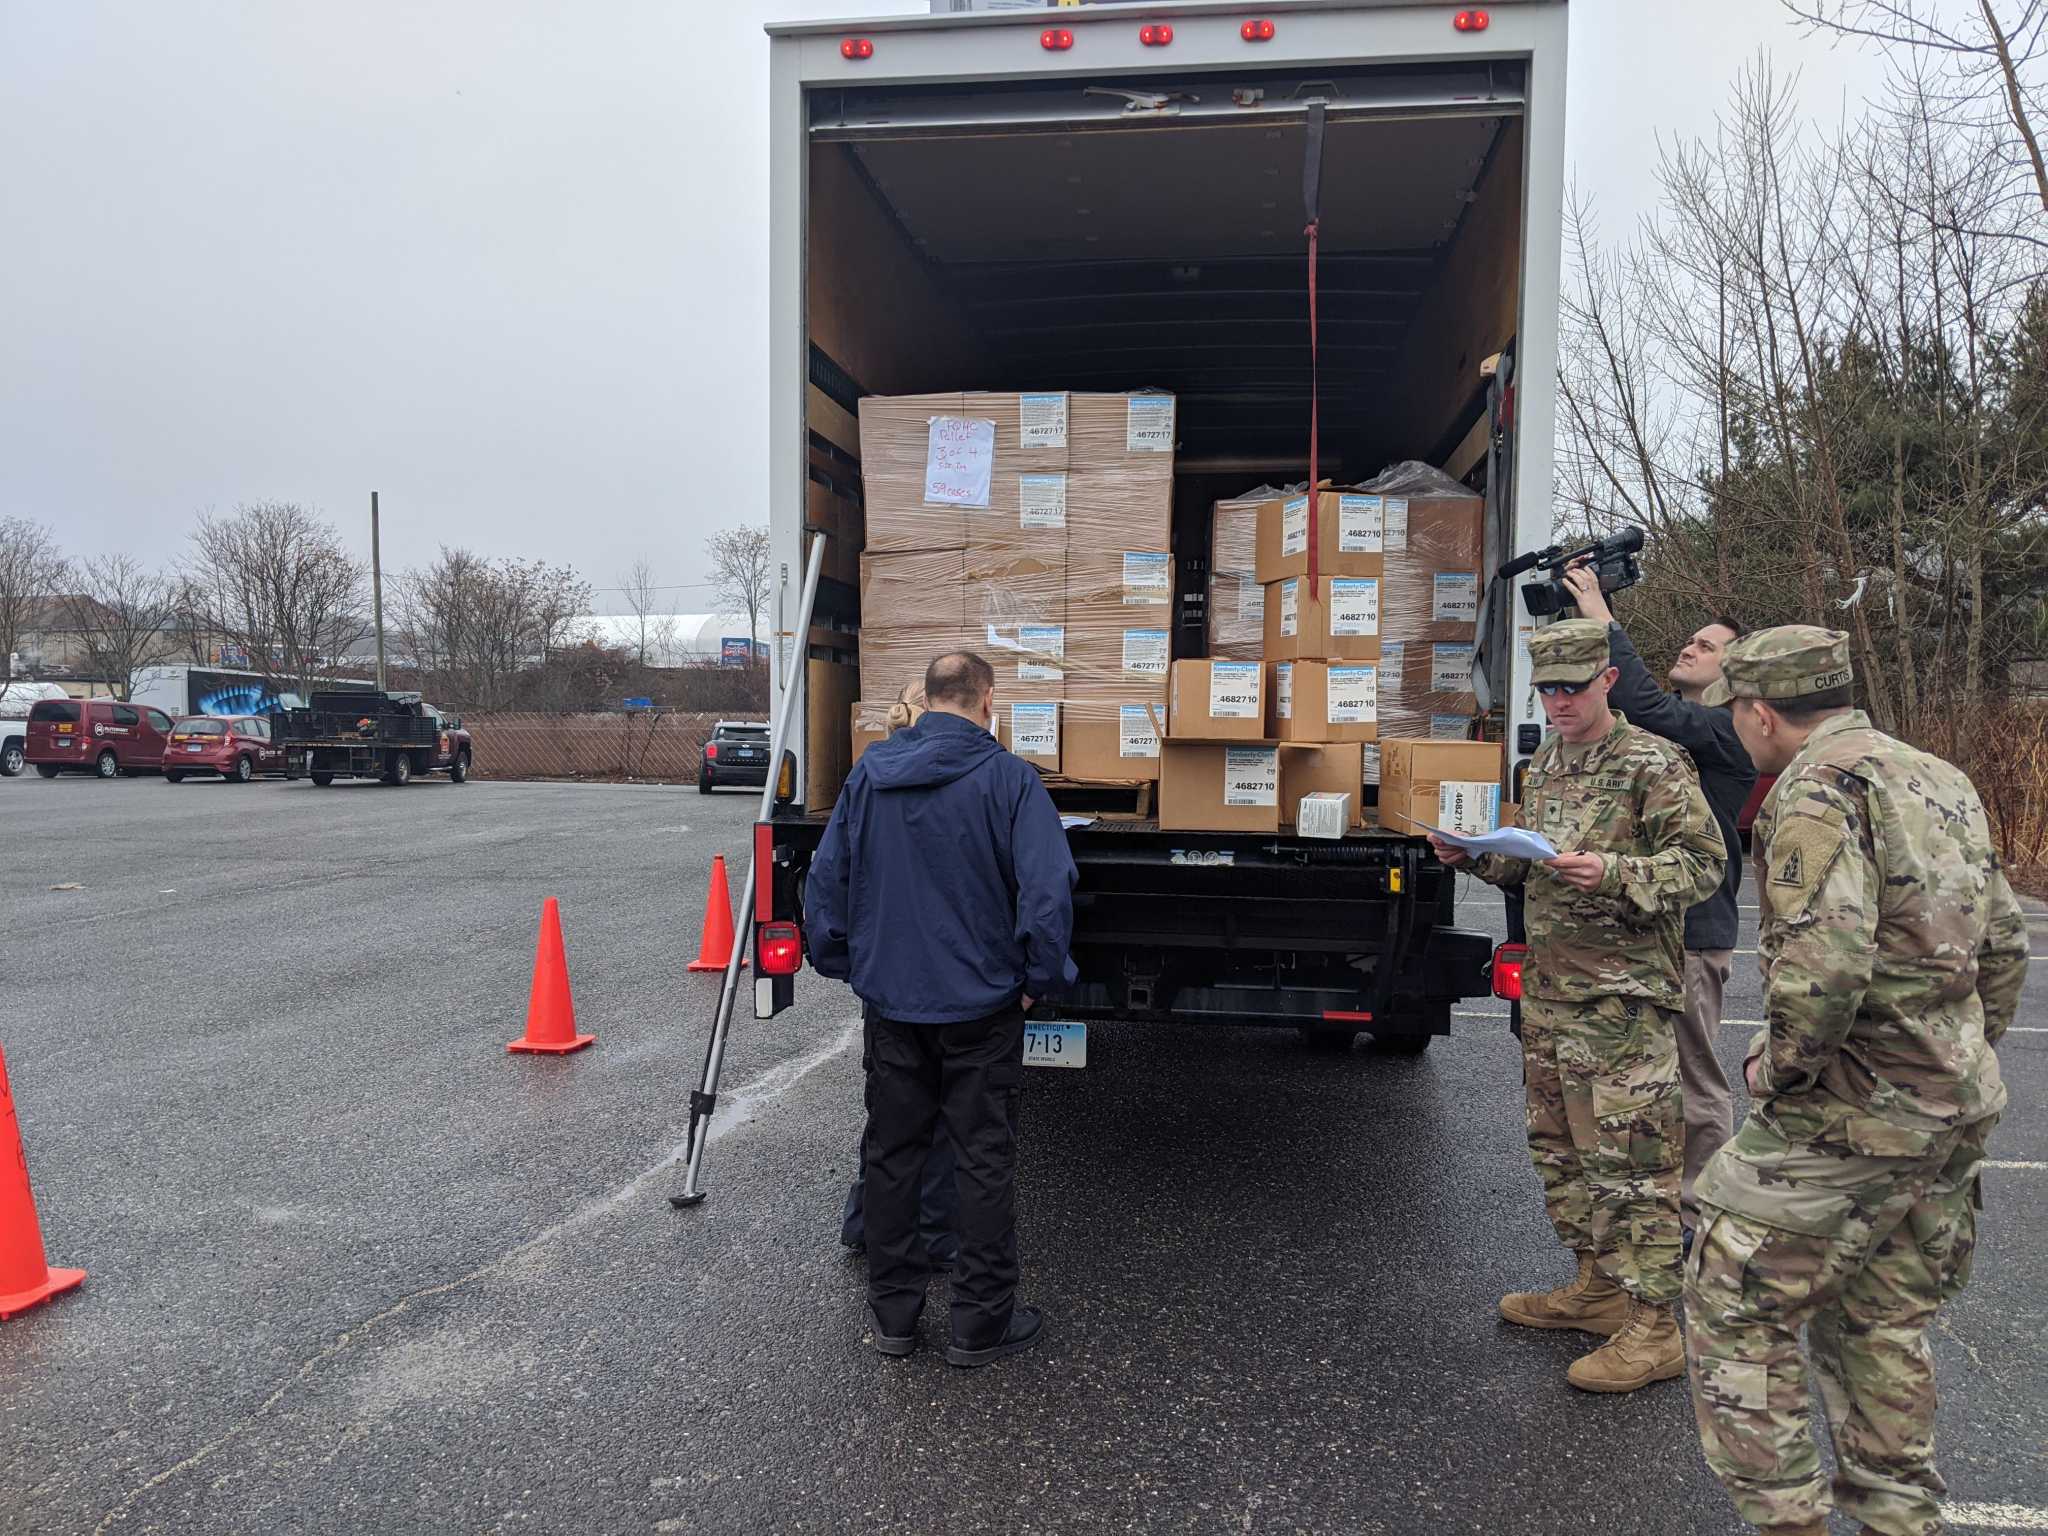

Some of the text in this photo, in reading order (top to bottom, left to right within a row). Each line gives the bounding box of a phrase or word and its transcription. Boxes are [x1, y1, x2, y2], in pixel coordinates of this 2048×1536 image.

[1029, 426, 1064, 436] 4672717
[1136, 430, 1171, 440] 4672717
[936, 446, 947, 460] 3
[968, 447, 977, 459] 4
[1029, 506, 1064, 516] 4672717
[1347, 529, 1381, 539] 4682710
[1383, 529, 1405, 537] 2710
[1441, 601, 1476, 610] 4682710
[1339, 613, 1376, 621] 4682710
[1131, 662, 1166, 670] 4672717
[1815, 671, 1850, 689] CURTIS
[1219, 695, 1258, 704] 4682710
[1337, 699, 1375, 708] 4682710
[1020, 735, 1054, 743] 4672717
[1129, 738, 1158, 746] 467271
[1235, 782, 1275, 791] 4682710
